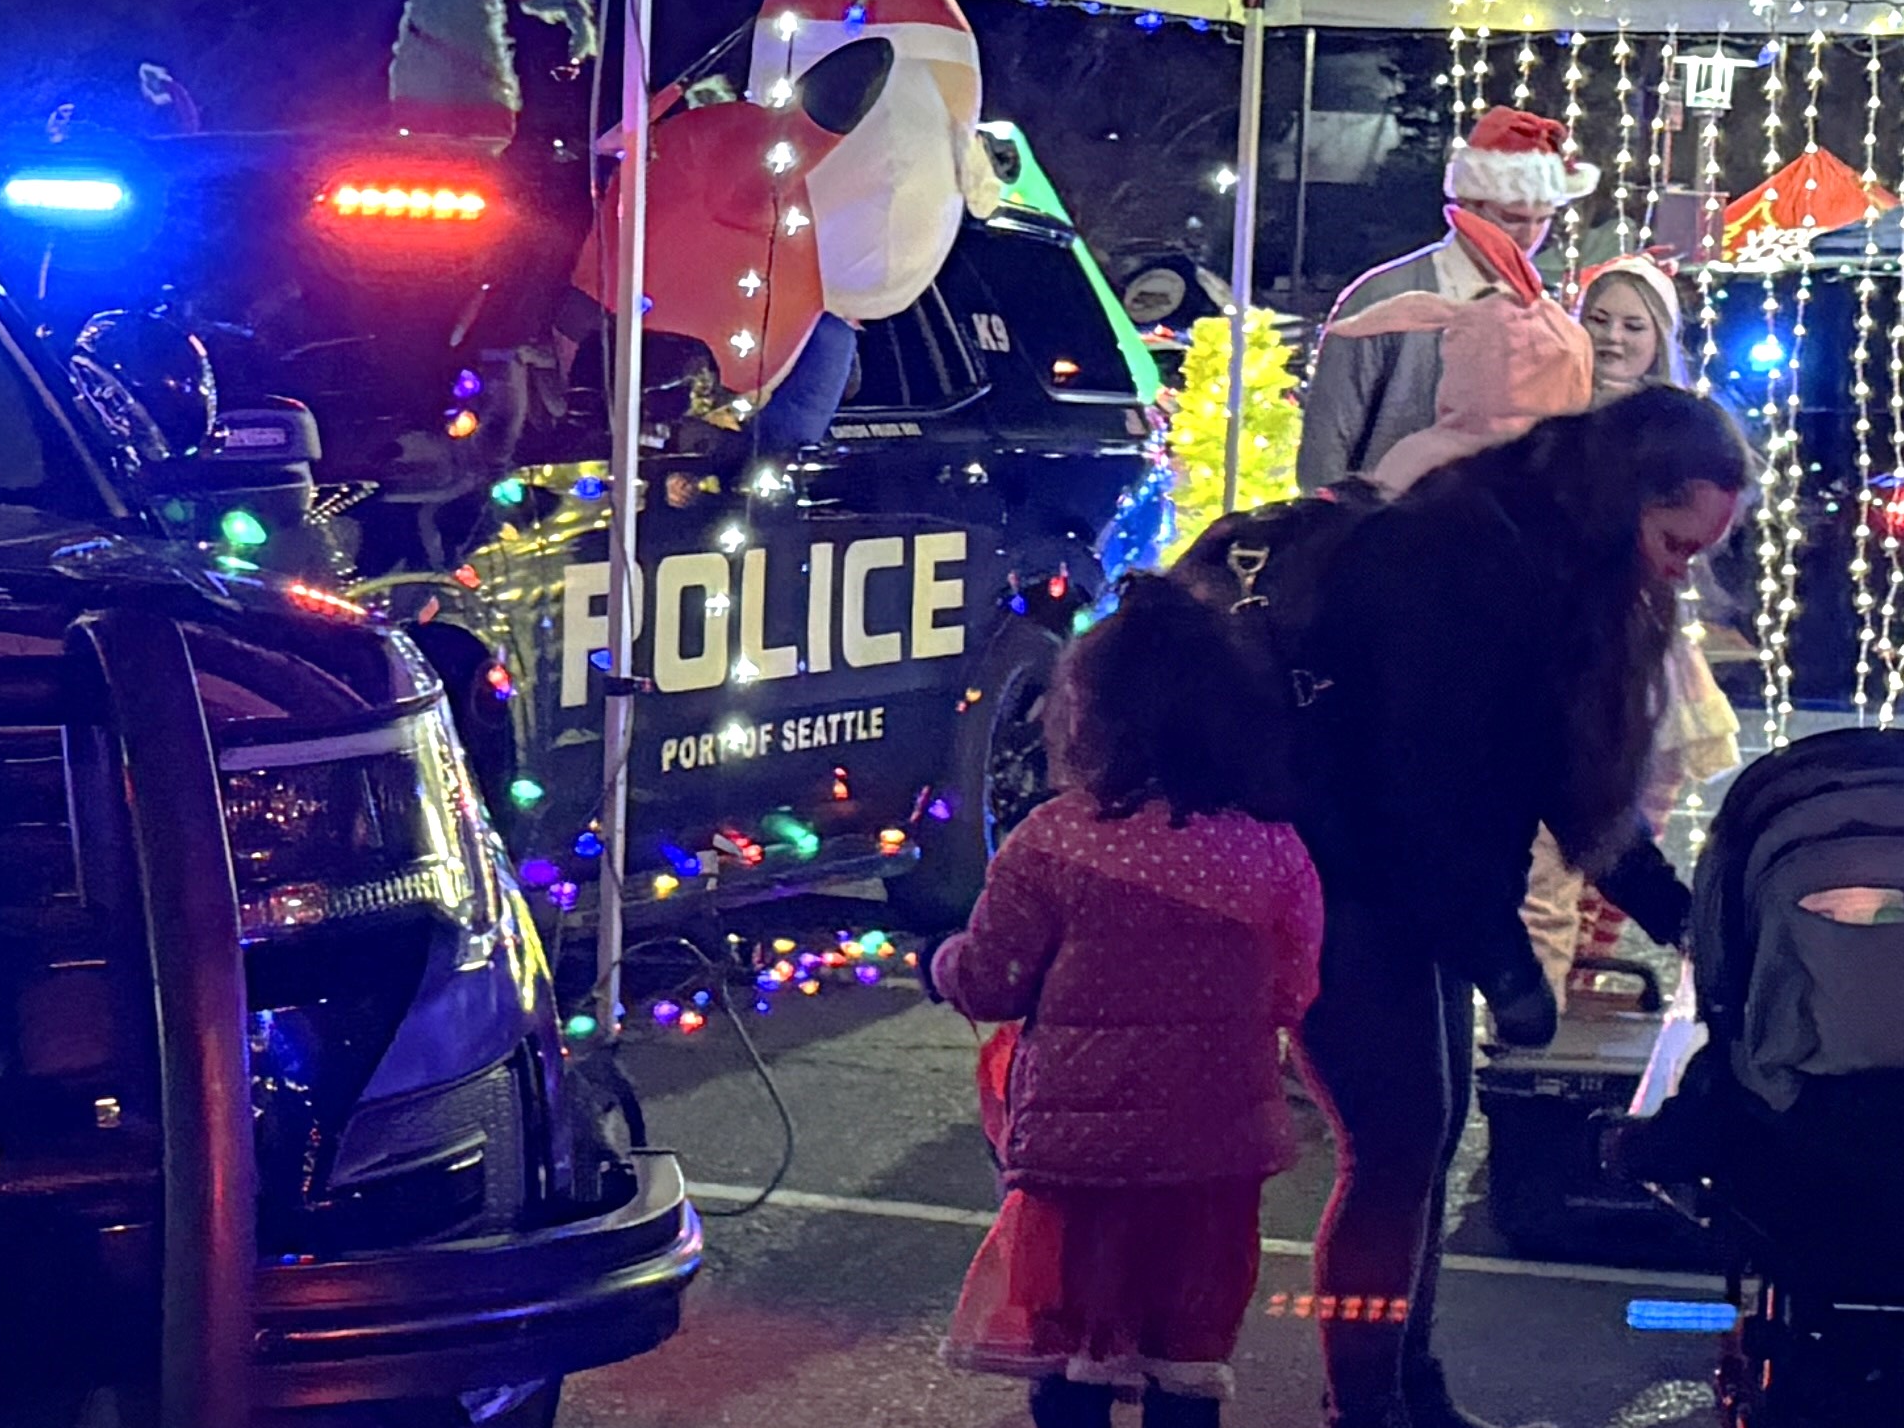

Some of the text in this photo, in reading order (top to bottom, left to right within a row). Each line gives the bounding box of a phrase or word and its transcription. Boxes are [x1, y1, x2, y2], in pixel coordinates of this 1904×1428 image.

[972, 313, 1011, 353] K9
[560, 531, 967, 708] POLICE
[661, 707, 885, 773] PORT OF SEATTLE
